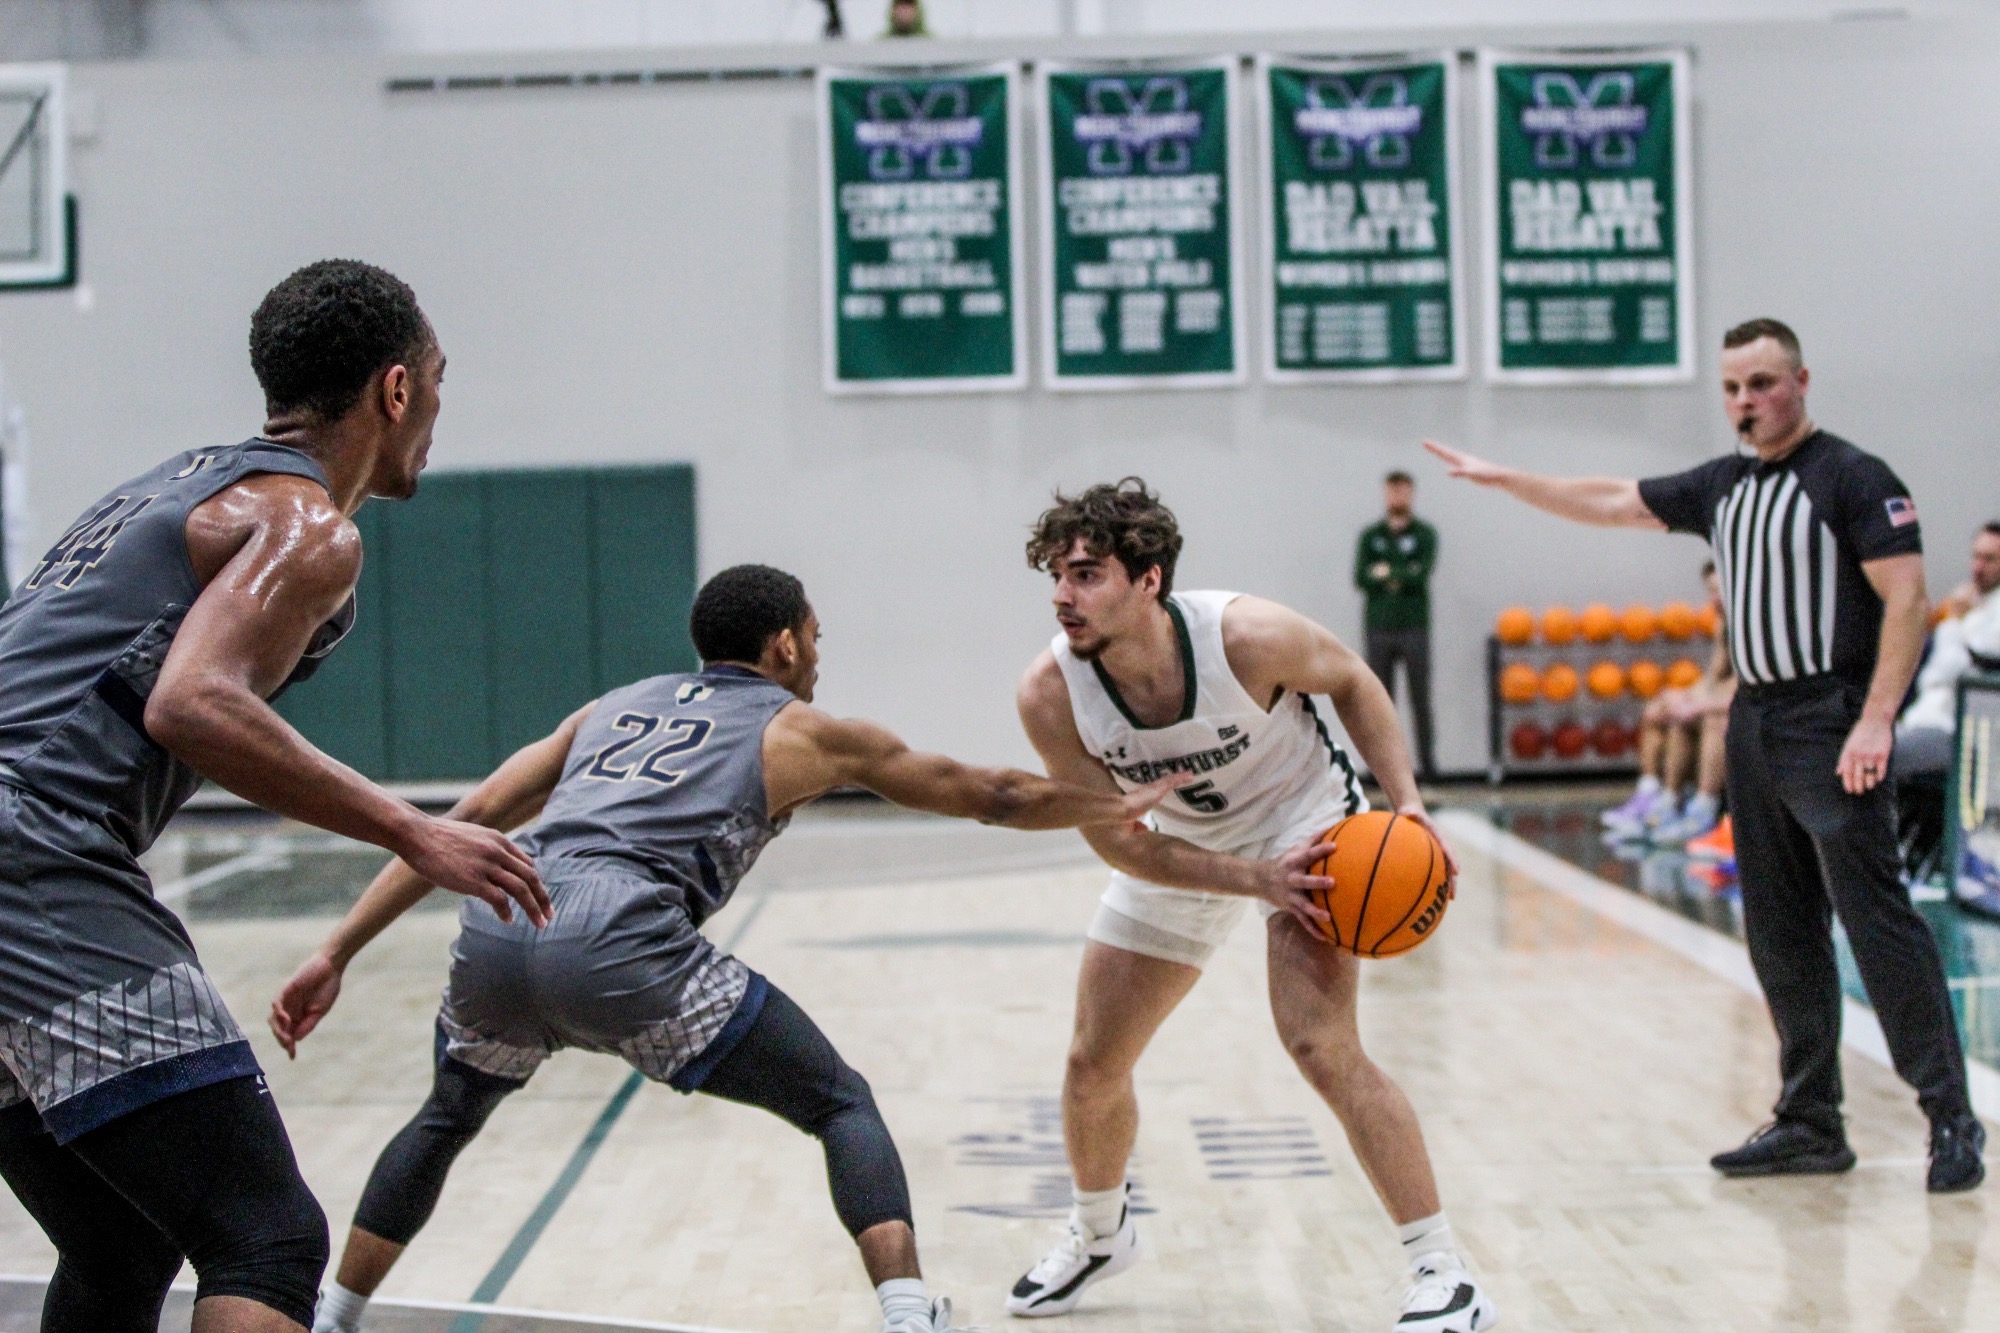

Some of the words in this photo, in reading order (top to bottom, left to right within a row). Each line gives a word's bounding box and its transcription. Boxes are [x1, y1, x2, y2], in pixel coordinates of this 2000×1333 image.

[1286, 181, 1355, 213] DAD
[1510, 180, 1580, 211] DAD
[849, 211, 995, 239] CHAMPIONS
[1069, 206, 1214, 235] CHAMPIONS
[1288, 215, 1436, 252] REGATTA
[1513, 213, 1662, 250] REGATTA
[25, 494, 160, 590] 44
[582, 711, 716, 787] 22
[1174, 778, 1230, 813] 5
